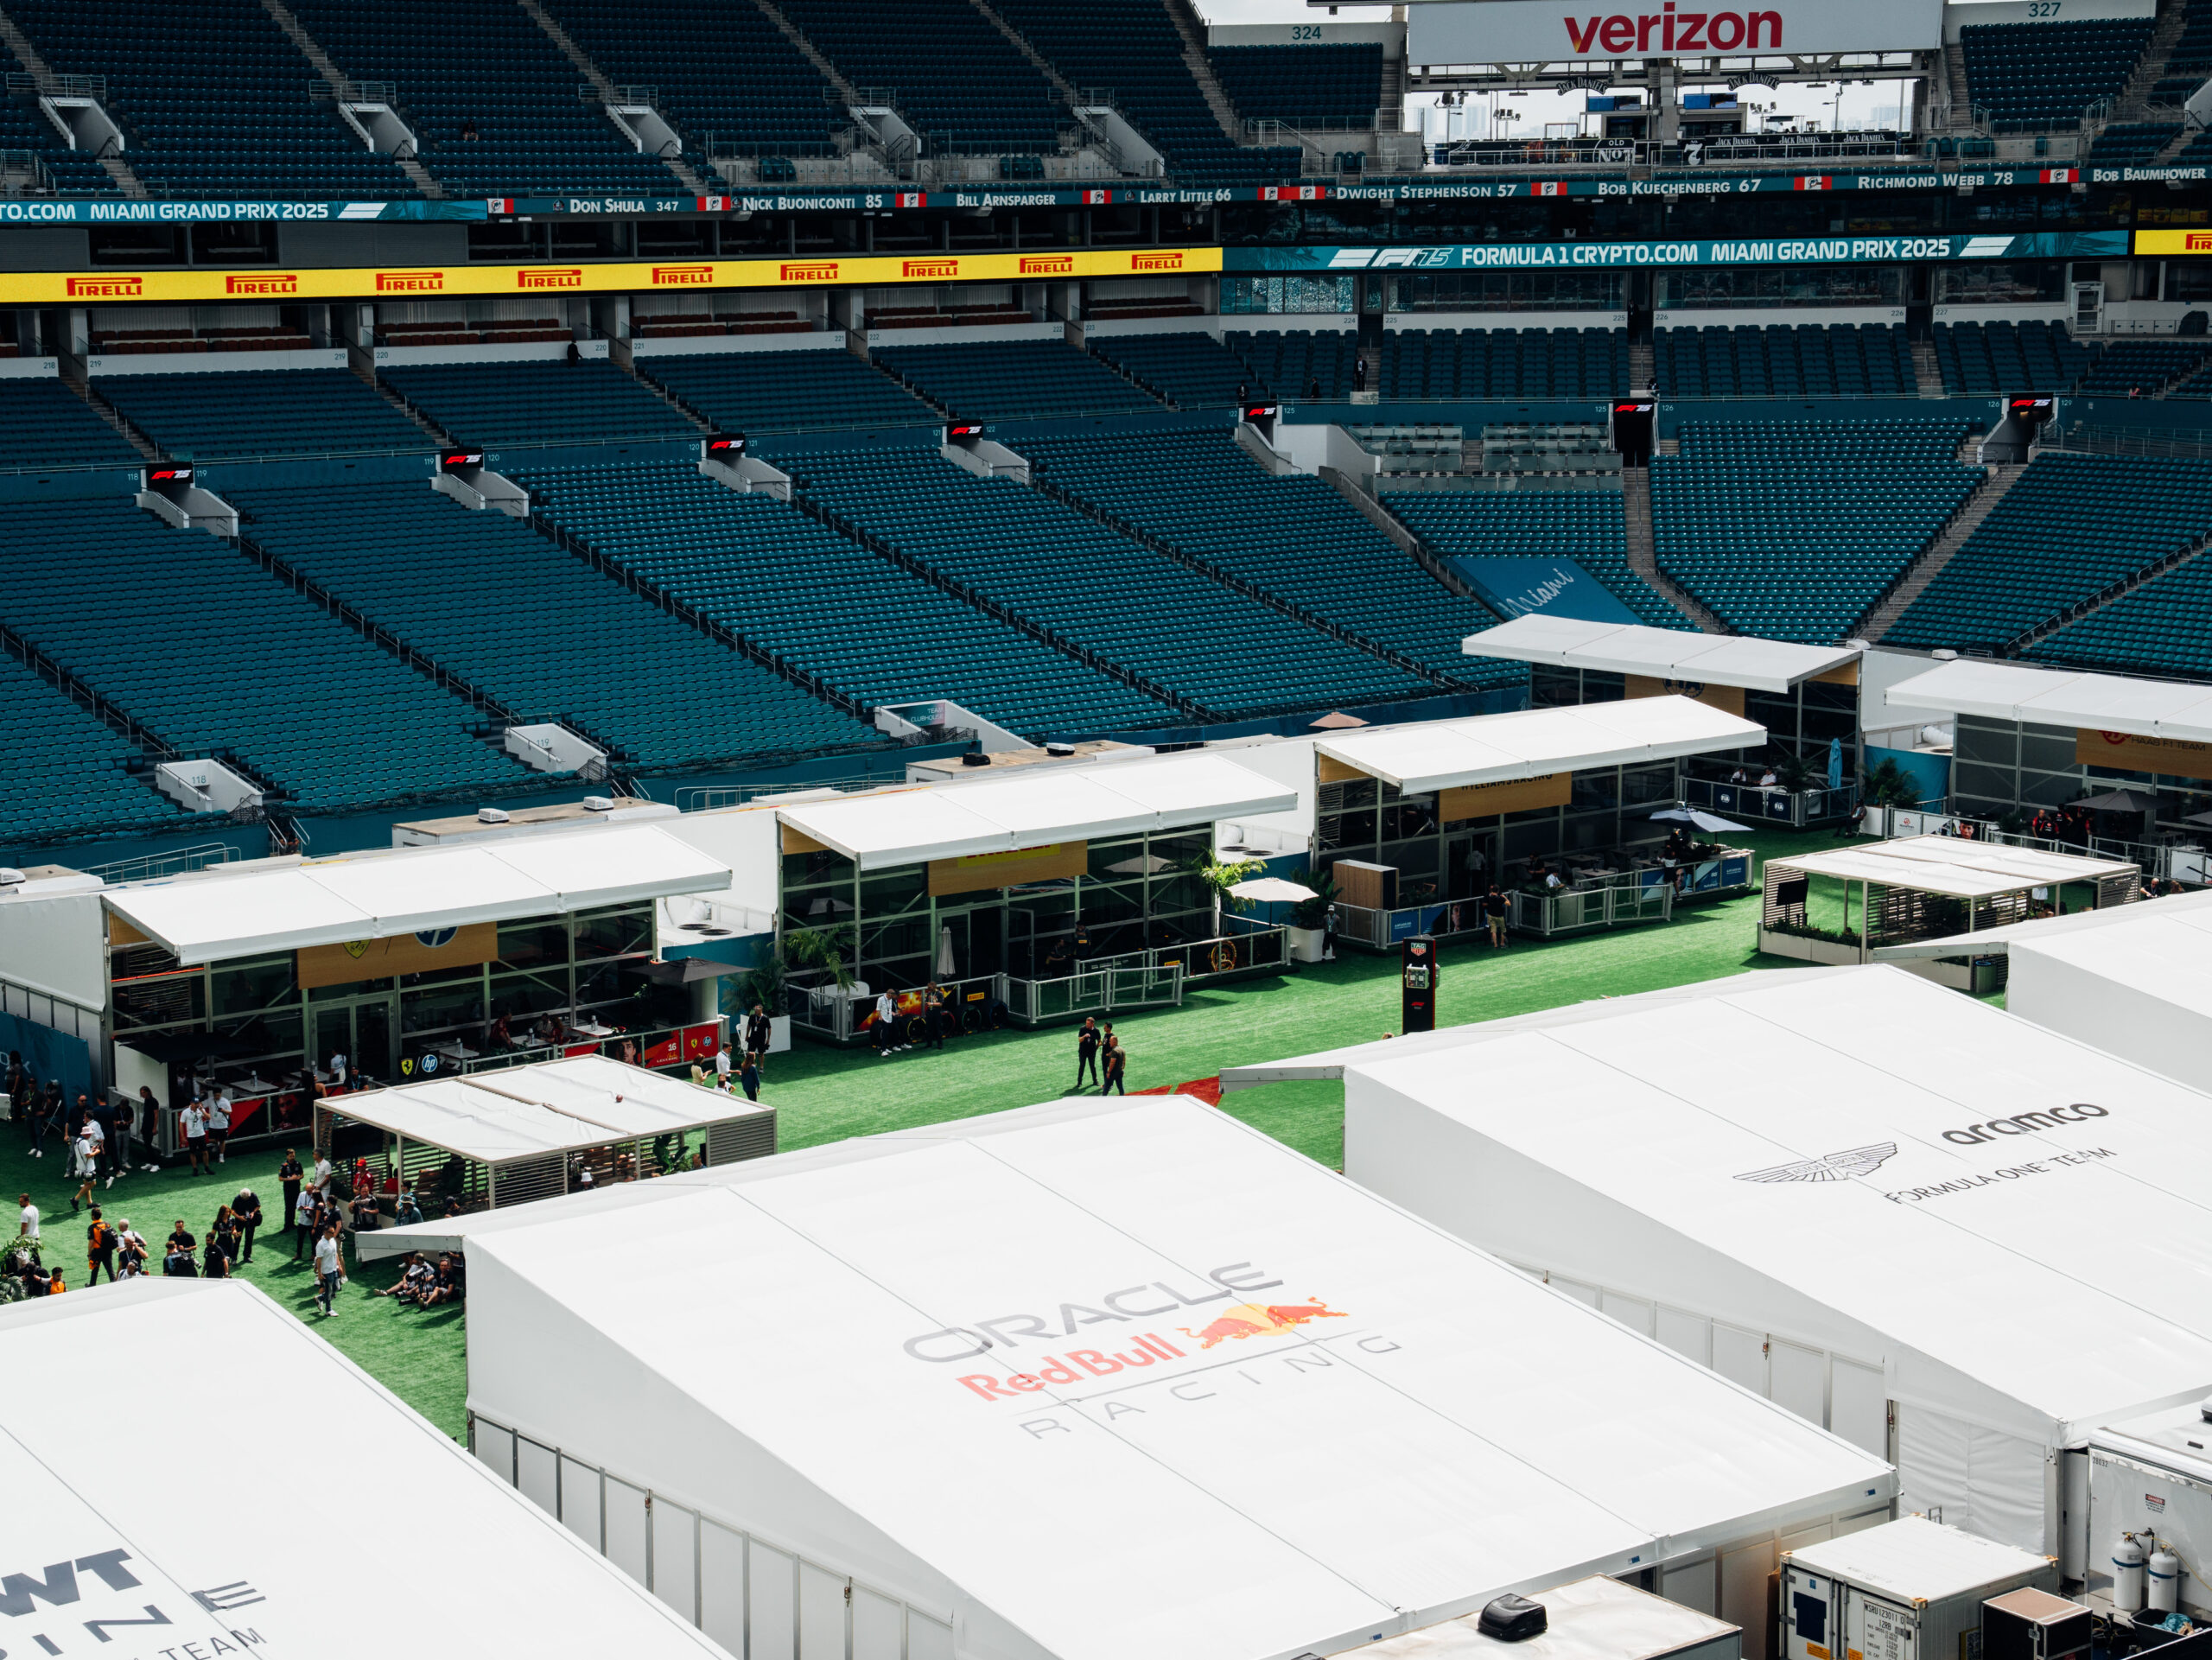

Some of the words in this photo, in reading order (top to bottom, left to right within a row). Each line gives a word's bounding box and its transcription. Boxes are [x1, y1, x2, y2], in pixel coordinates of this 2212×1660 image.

[2028, 3, 2062, 17] 327
[1291, 25, 1322, 41] 324
[1563, 2, 1783, 53] verizon
[1557, 80, 1577, 96] JACK
[1728, 74, 1749, 91] JACK
[1715, 137, 1732, 146] JACK
[1779, 136, 1796, 144] JACK
[1843, 134, 1860, 143] JACK
[1684, 143, 1703, 166] 7
[1858, 175, 1936, 189] RICHMOND
[1942, 173, 1985, 187] WEBB
[1993, 172, 2014, 186] 78
[2093, 169, 2120, 182] BOB
[2123, 167, 2206, 181] BAUMHOWER
[1337, 186, 1395, 200] DWIGHT
[1401, 185, 1491, 199] STEPHENSON
[1497, 184, 1517, 197] 57
[1599, 182, 1627, 195] BOB
[1632, 181, 1730, 194] KUECHENBERG
[1738, 179, 1762, 193] 67
[742, 197, 773, 211] NICK
[778, 196, 855, 210] BUONICONTI
[865, 194, 883, 208] 85
[957, 194, 979, 207] BILL
[982, 193, 1056, 207] ARNSPARGER
[1140, 190, 1178, 204] LARRY
[1180, 189, 1213, 202] LITTLE
[1215, 188, 1232, 201] 66
[0, 204, 76, 219] TO.COM
[91, 204, 157, 219] MIAMI
[159, 203, 231, 219] GRAND
[235, 203, 278, 219] PRIX
[283, 203, 328, 219] 2025
[569, 199, 601, 213] DON
[605, 198, 645, 213] SHULA
[656, 201, 679, 212] 347
[1462, 246, 1553, 266] FORMULA
[1559, 246, 1569, 264] 1
[1573, 244, 1698, 264] CRYPTO.COM
[1711, 242, 1773, 262] MIAMI
[1777, 241, 1849, 260] GRAND
[1852, 239, 1898, 258] PRIX
[1901, 239, 1951, 258] 2025
[902, 259, 958, 277] PIRELLI
[1020, 257, 1073, 273] PIRELLI
[1131, 253, 1183, 270] PIRELLI
[518, 269, 582, 288] PIRELLI
[652, 266, 713, 284] PIRELLI
[780, 263, 838, 281] PIRELLI
[66, 277, 143, 296] PIRELLI
[226, 275, 297, 294] PIRELLI
[376, 272, 443, 291] PIRELLI
[1344, 316, 1356, 325] 224
[1385, 316, 1398, 325] 225
[1612, 314, 1626, 322] 225
[1656, 313, 1669, 321] 226
[869, 333, 880, 341] 222
[634, 342, 645, 351] 221
[334, 353, 346, 361] 219
[376, 351, 389, 359] 220
[43, 360, 56, 370] 218
[89, 359, 102, 369] 219
[2132, 736, 2160, 747] HAAS
[2163, 739, 2173, 747] F1
[2177, 741, 2205, 751] TEAM
[192, 775, 207, 784] 118
[668, 1043, 677, 1052] 16
[423, 1055, 436, 1072] hp
[1942, 1103, 2109, 1145] aramco
[1885, 1173, 2000, 1205] FORMULA
[2048, 1148, 2117, 1167] TEAM
[903, 1261, 1284, 1363] ORACLE
[1019, 1334, 1402, 1440] RACING
[158, 1627, 268, 1660] TEAM
